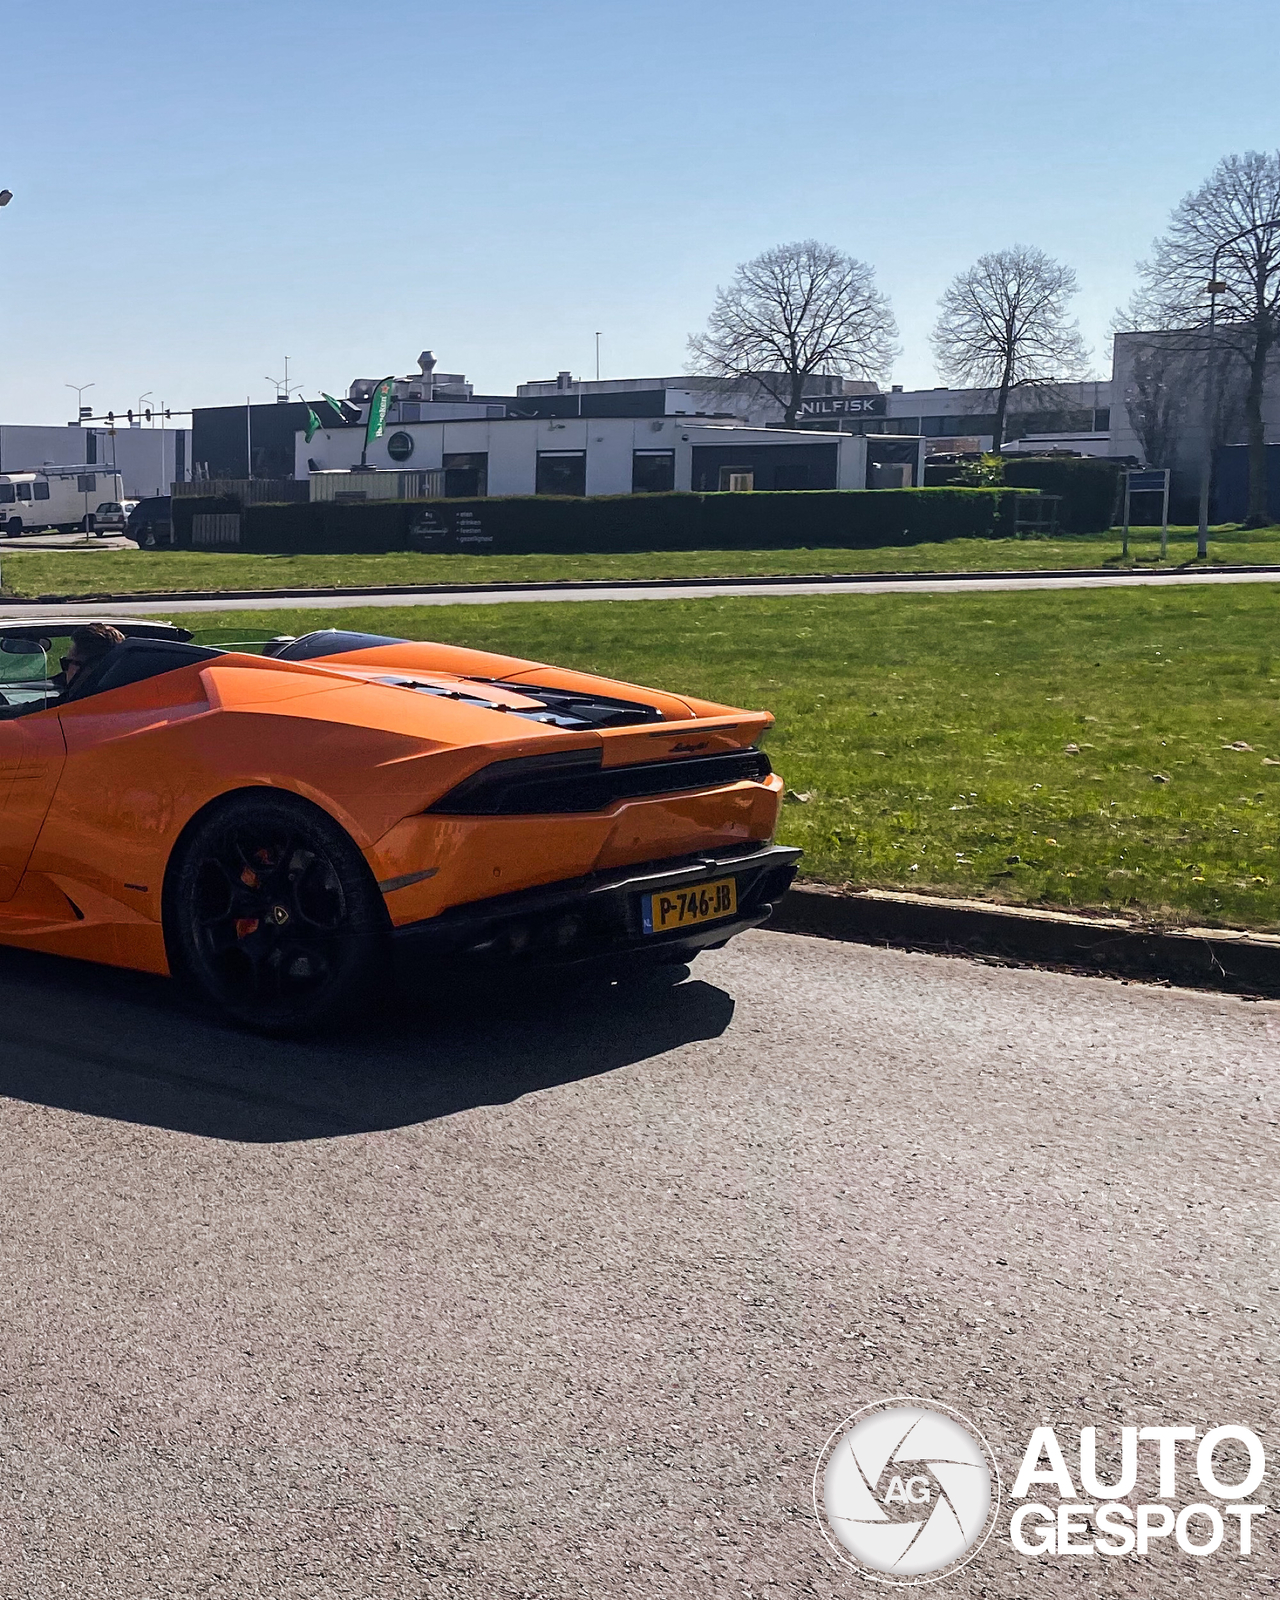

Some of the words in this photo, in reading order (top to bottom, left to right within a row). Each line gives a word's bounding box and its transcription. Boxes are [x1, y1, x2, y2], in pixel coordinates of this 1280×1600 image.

[801, 400, 875, 414] NILFISK
[660, 885, 731, 925] P-746-JB
[643, 918, 652, 927] NL
